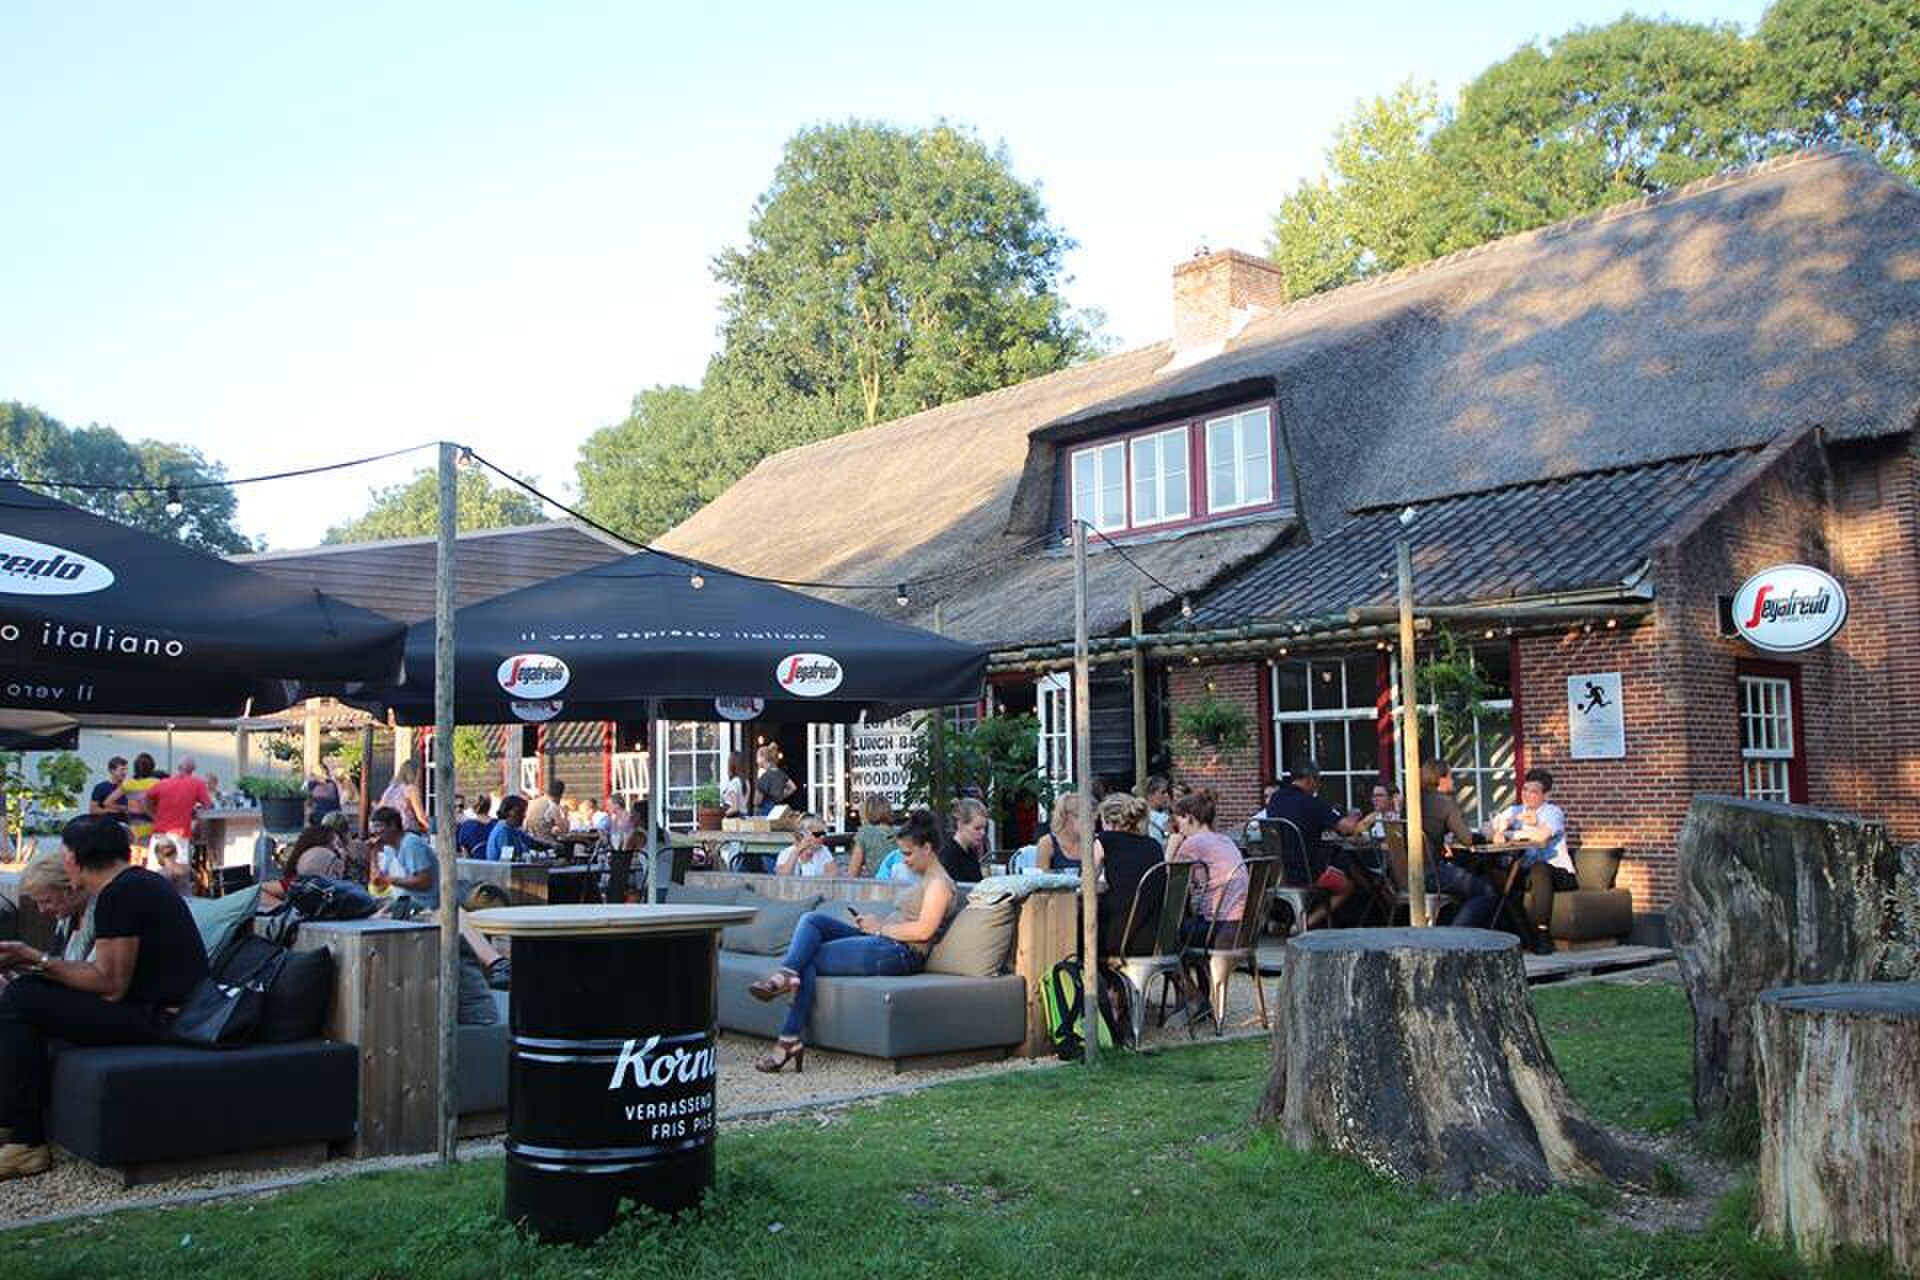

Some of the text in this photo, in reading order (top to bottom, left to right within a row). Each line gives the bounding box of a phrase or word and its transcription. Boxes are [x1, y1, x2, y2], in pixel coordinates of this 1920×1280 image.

[1745, 584, 1831, 629] Segafredo
[42, 622, 184, 657] italiano
[549, 633, 604, 641] vero
[616, 629, 721, 641] espresso
[735, 630, 827, 640] italiano
[503, 657, 565, 687] Segafredo
[782, 656, 839, 685] Segafredo
[850, 735, 894, 752] LUNCH
[651, 1119, 686, 1141] FRIS
